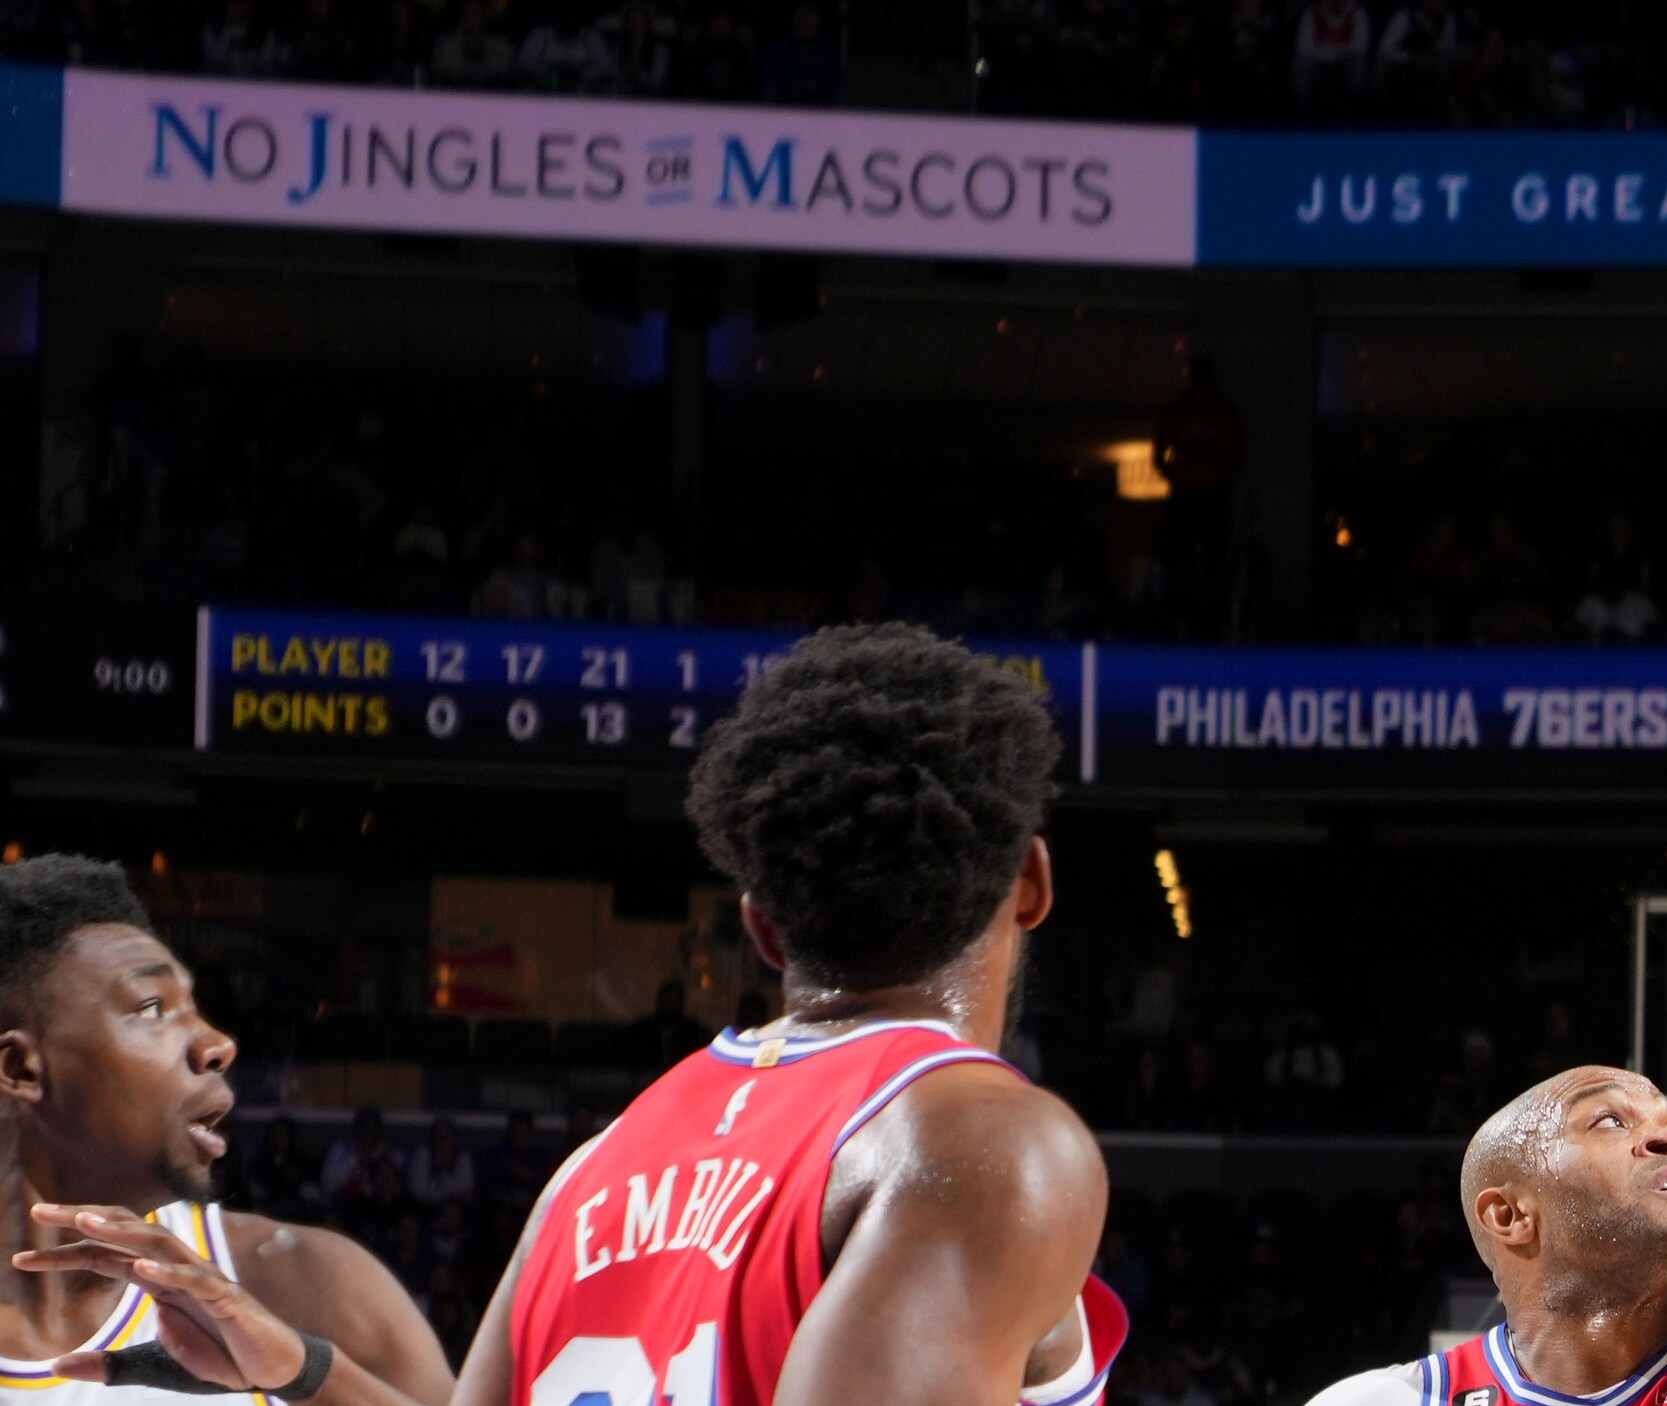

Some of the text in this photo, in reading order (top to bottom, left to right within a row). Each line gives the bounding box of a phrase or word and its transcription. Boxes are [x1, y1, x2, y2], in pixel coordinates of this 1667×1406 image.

[146, 101, 1115, 225] NO JINGLES OR MASCOTS
[1298, 174, 1469, 223] JUST
[94, 662, 170, 694] 9:00
[232, 634, 391, 679] PLAYER
[422, 641, 464, 682] 12
[503, 644, 545, 682] 17
[581, 647, 628, 687] 21
[677, 652, 695, 690] 1
[232, 690, 696, 748] POINTS 0 0 13 2
[1155, 687, 1479, 749] PHILADELPHIA
